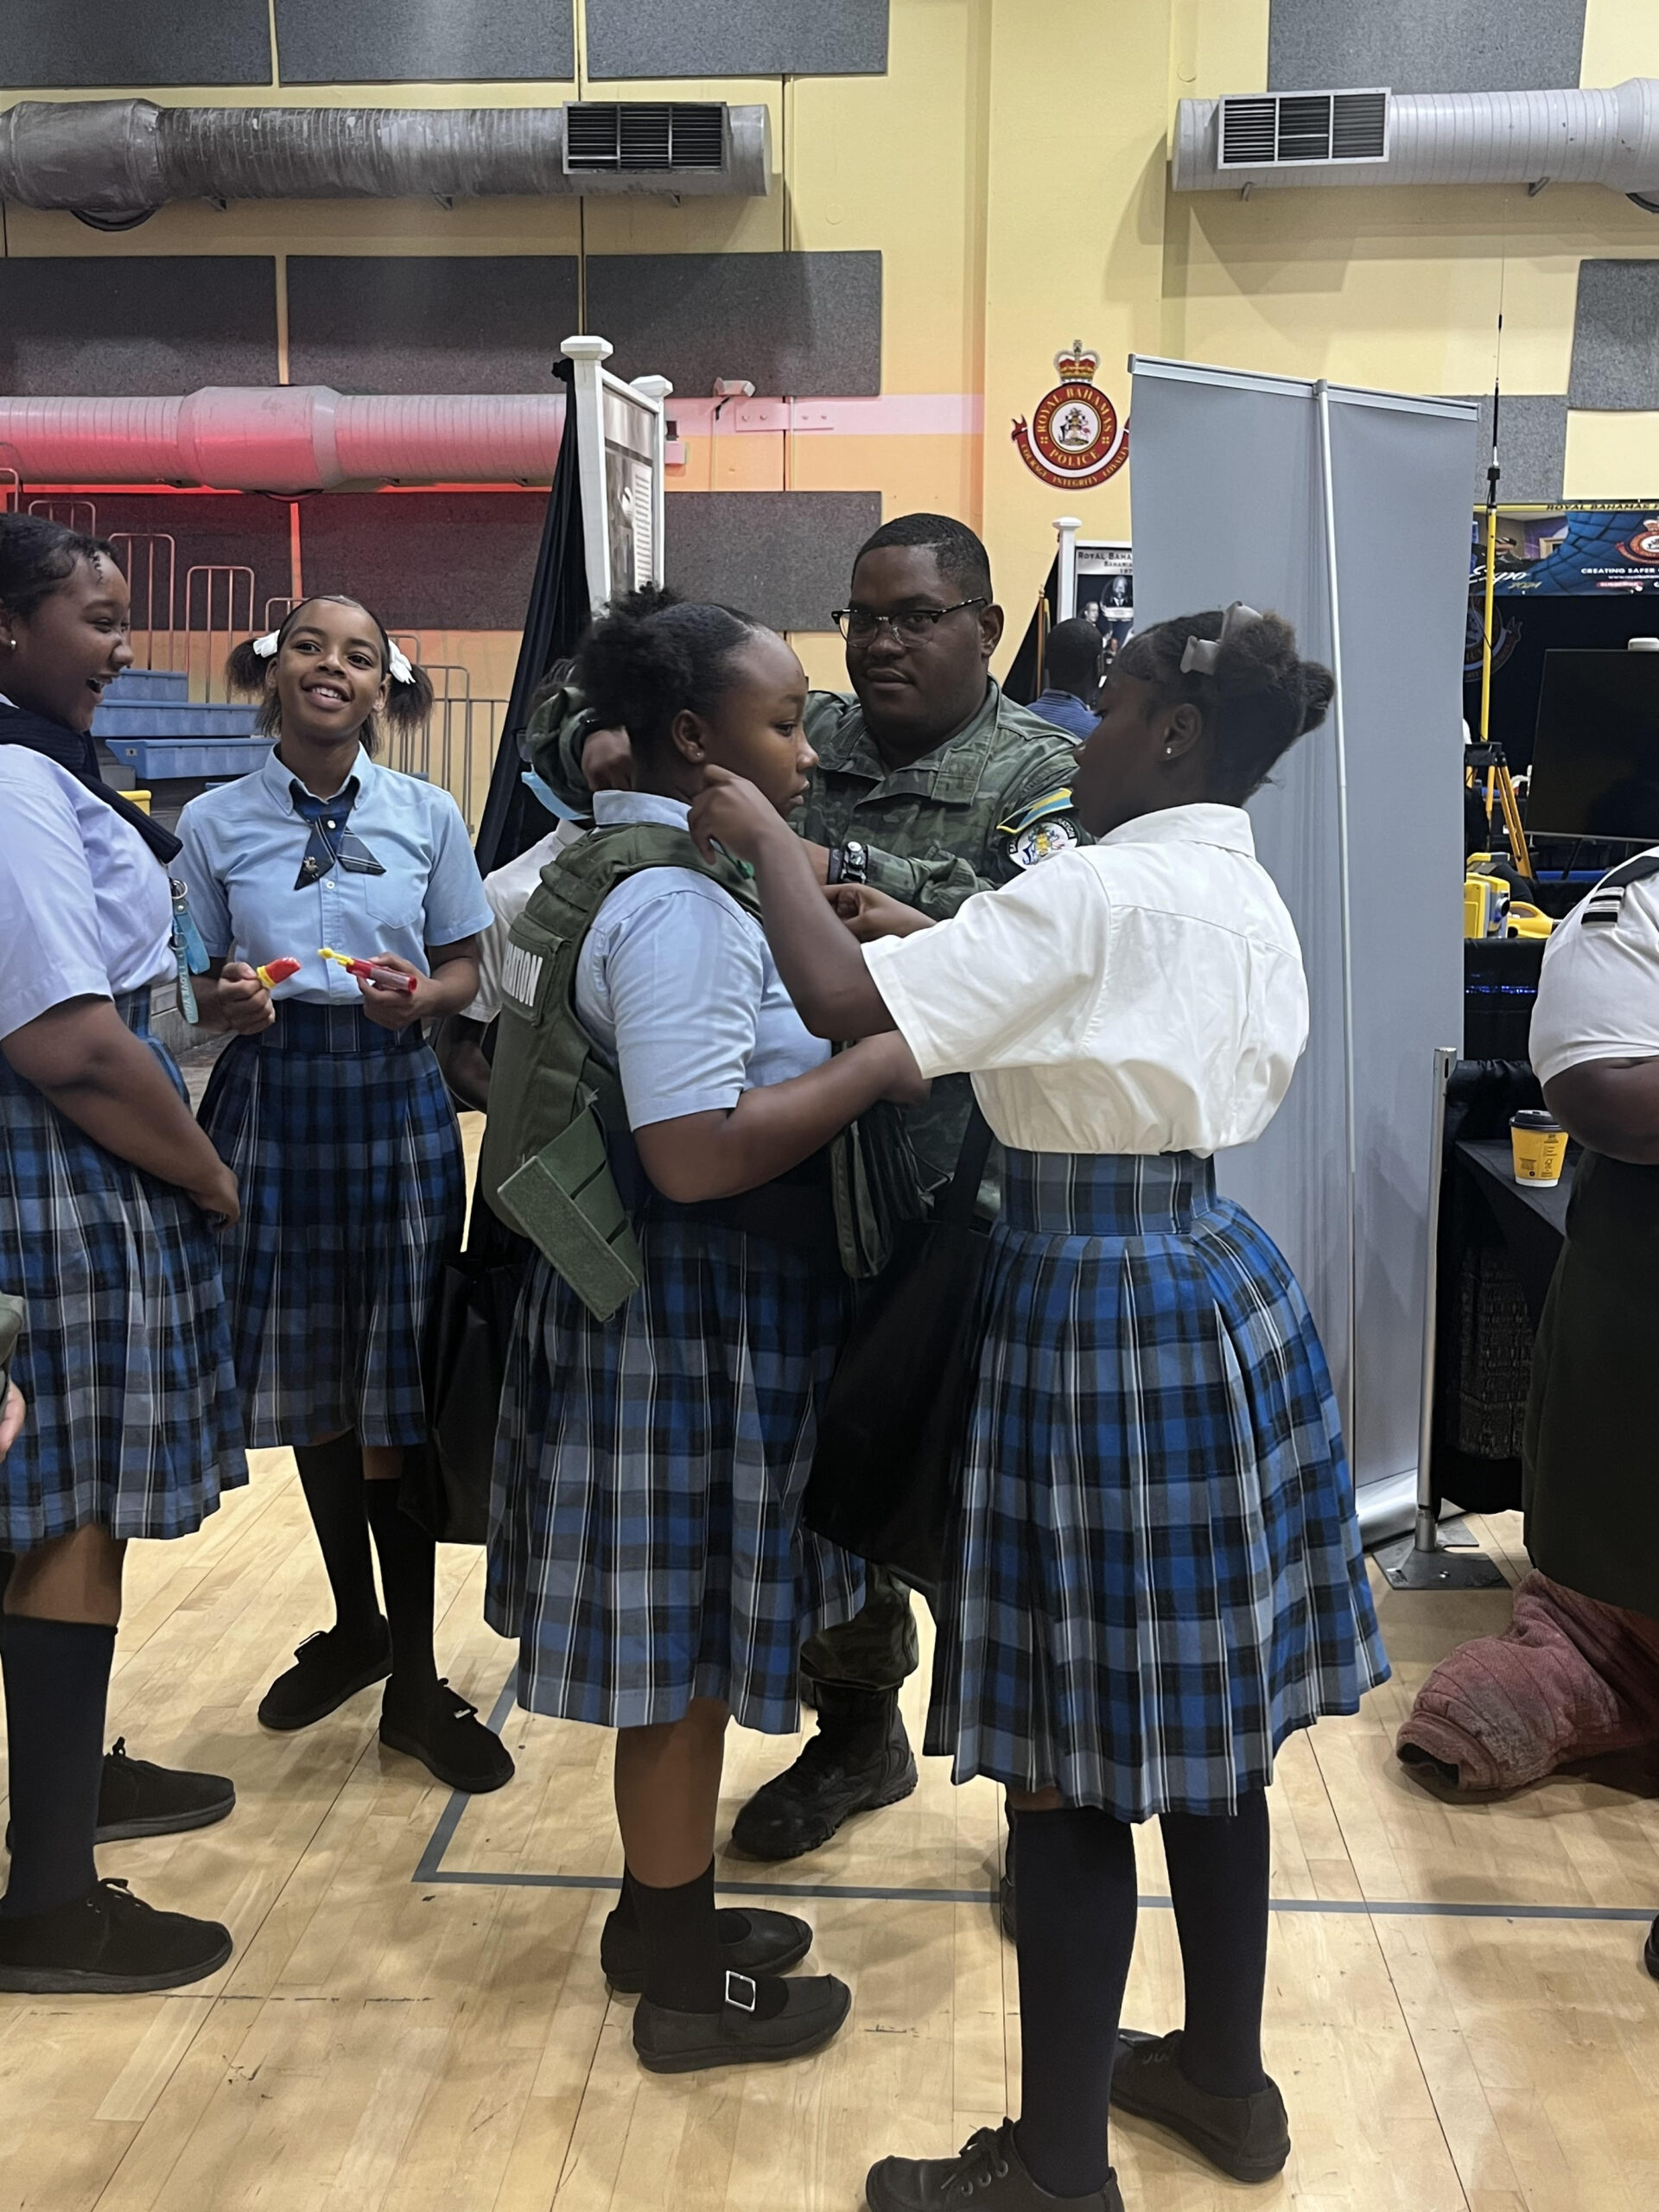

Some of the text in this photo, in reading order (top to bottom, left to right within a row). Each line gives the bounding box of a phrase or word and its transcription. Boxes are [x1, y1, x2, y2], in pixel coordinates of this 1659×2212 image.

[1037, 387, 1112, 433] ROYAL BAHAMAS
[1049, 448, 1100, 467] POLICE
[1052, 475, 1097, 486] INTEGRITY
[1077, 551, 1106, 560] ROYAL
[179, 972, 189, 995] LOVE
